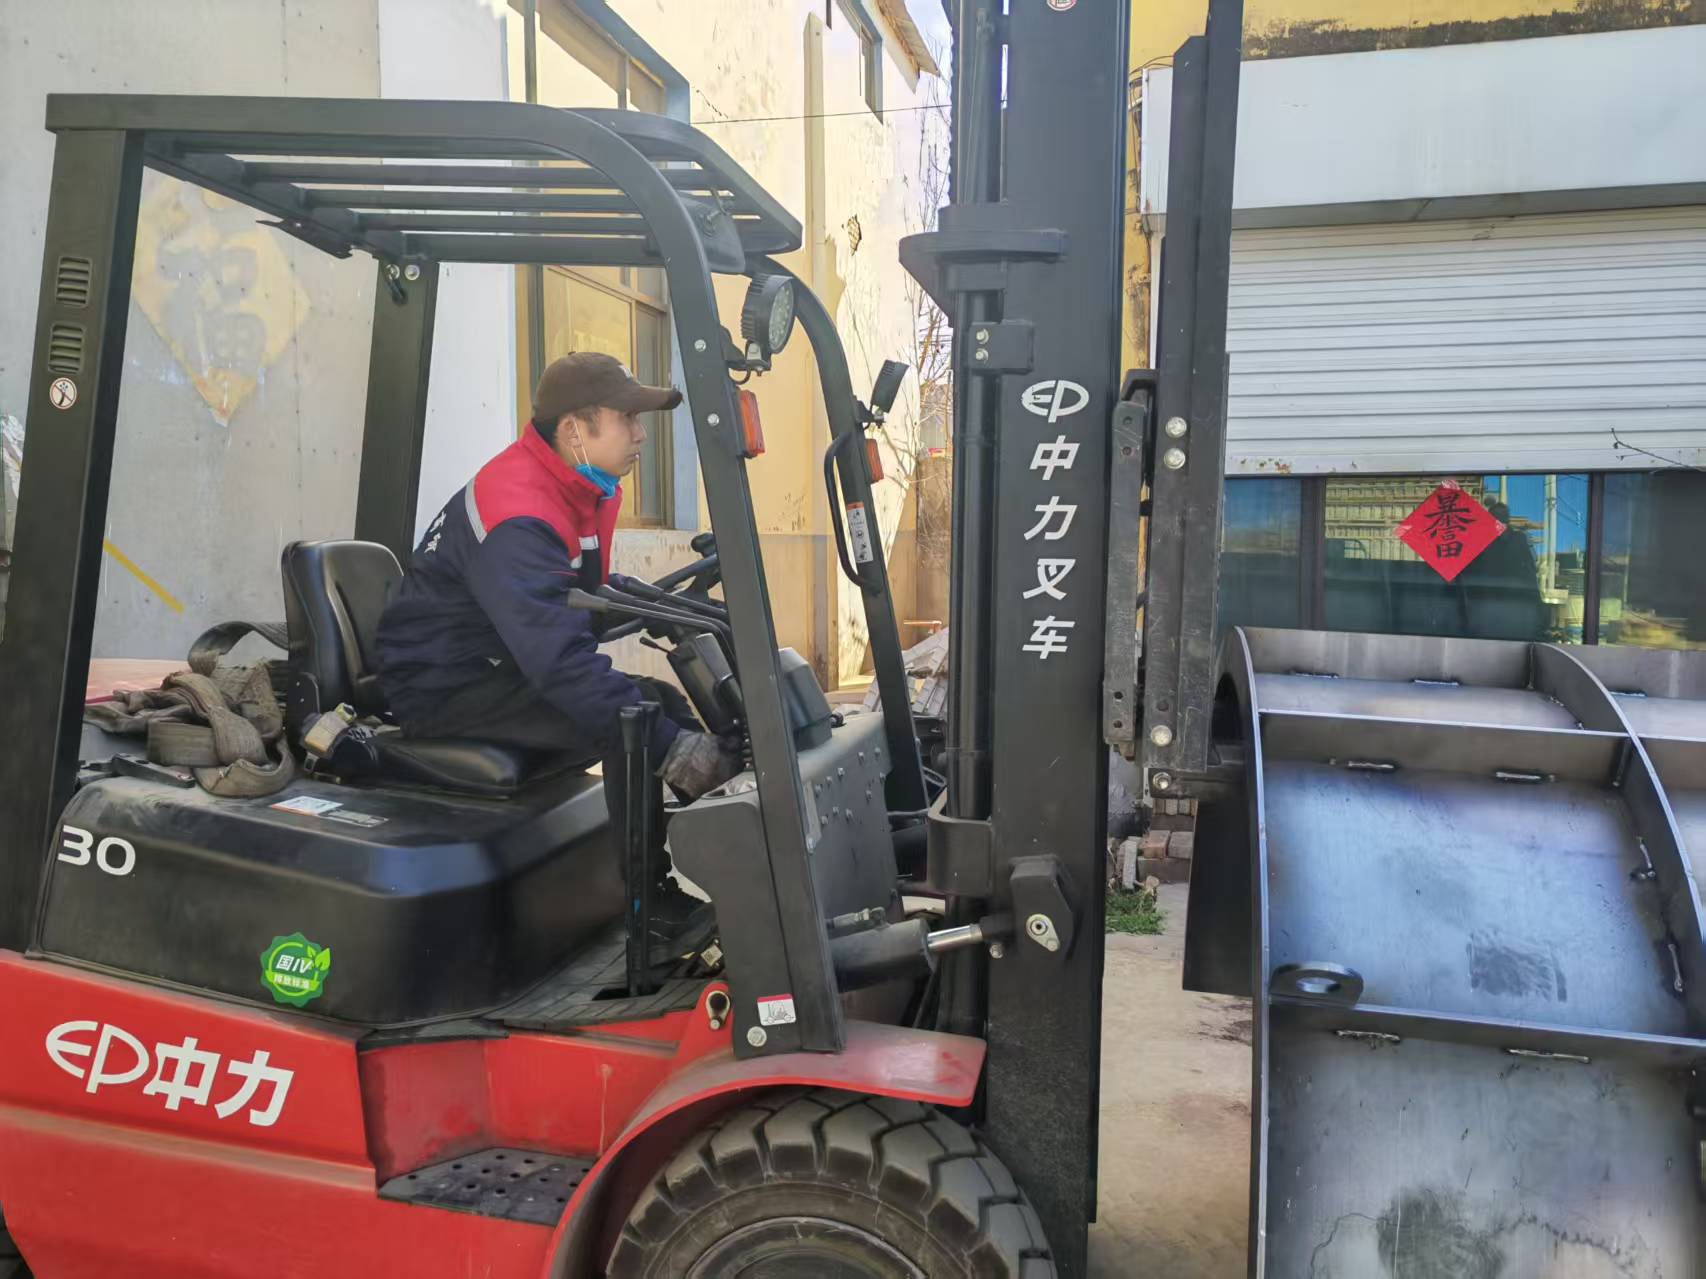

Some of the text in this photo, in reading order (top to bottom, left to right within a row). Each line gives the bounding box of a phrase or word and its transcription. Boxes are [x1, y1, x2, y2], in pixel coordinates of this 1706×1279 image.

[1022, 435, 1080, 660] 中力叉车
[58, 824, 136, 876] 30
[143, 1036, 295, 1127] 中力
